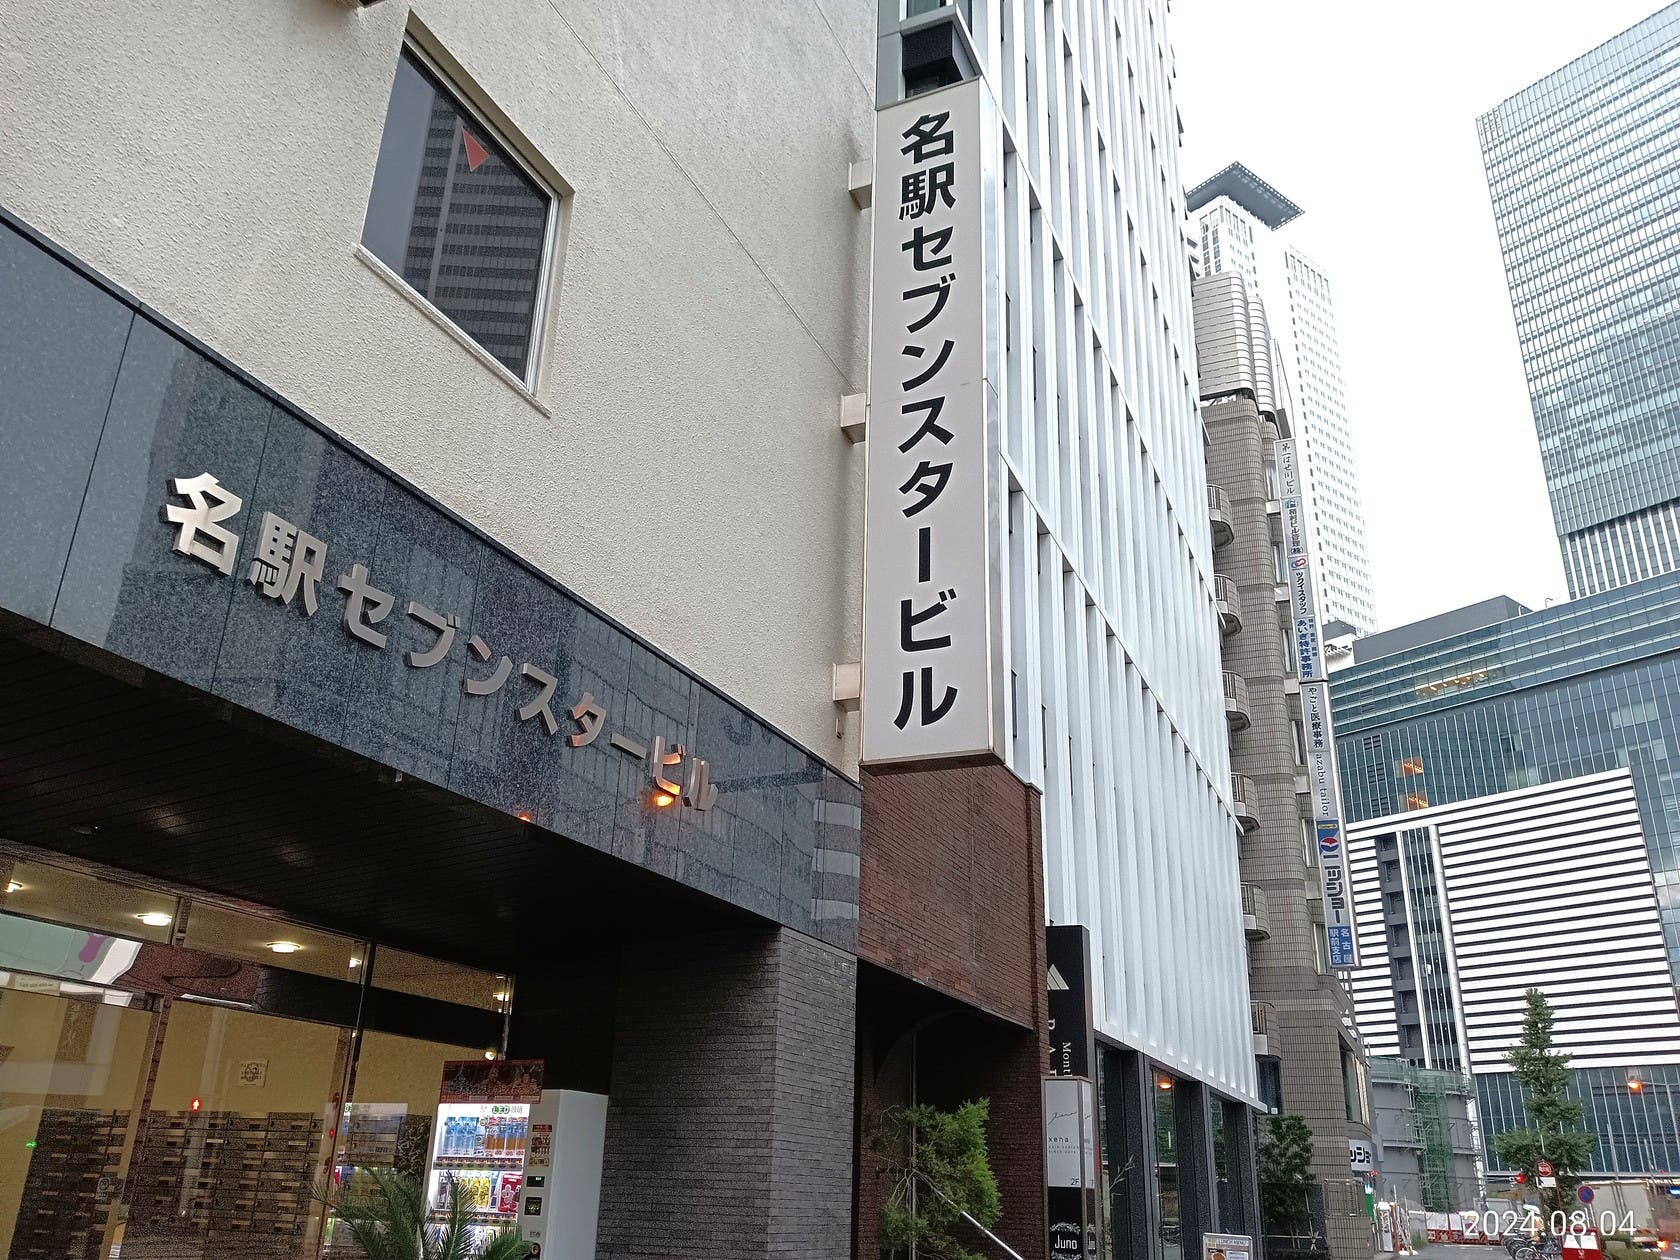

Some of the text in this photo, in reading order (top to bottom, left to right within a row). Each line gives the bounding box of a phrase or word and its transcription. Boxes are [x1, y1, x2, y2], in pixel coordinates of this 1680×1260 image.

[893, 111, 958, 731] 名駅セブンスタービル
[1295, 571, 1307, 615] ツクイスタッフ
[162, 471, 718, 811] 名駅セブンスタービル
[1316, 753, 1327, 785] azabu
[1319, 787, 1329, 816] tailor
[1330, 928, 1342, 964] 駅前支店
[1340, 928, 1353, 964] 名古屋
[1054, 1233, 1078, 1250] Juno
